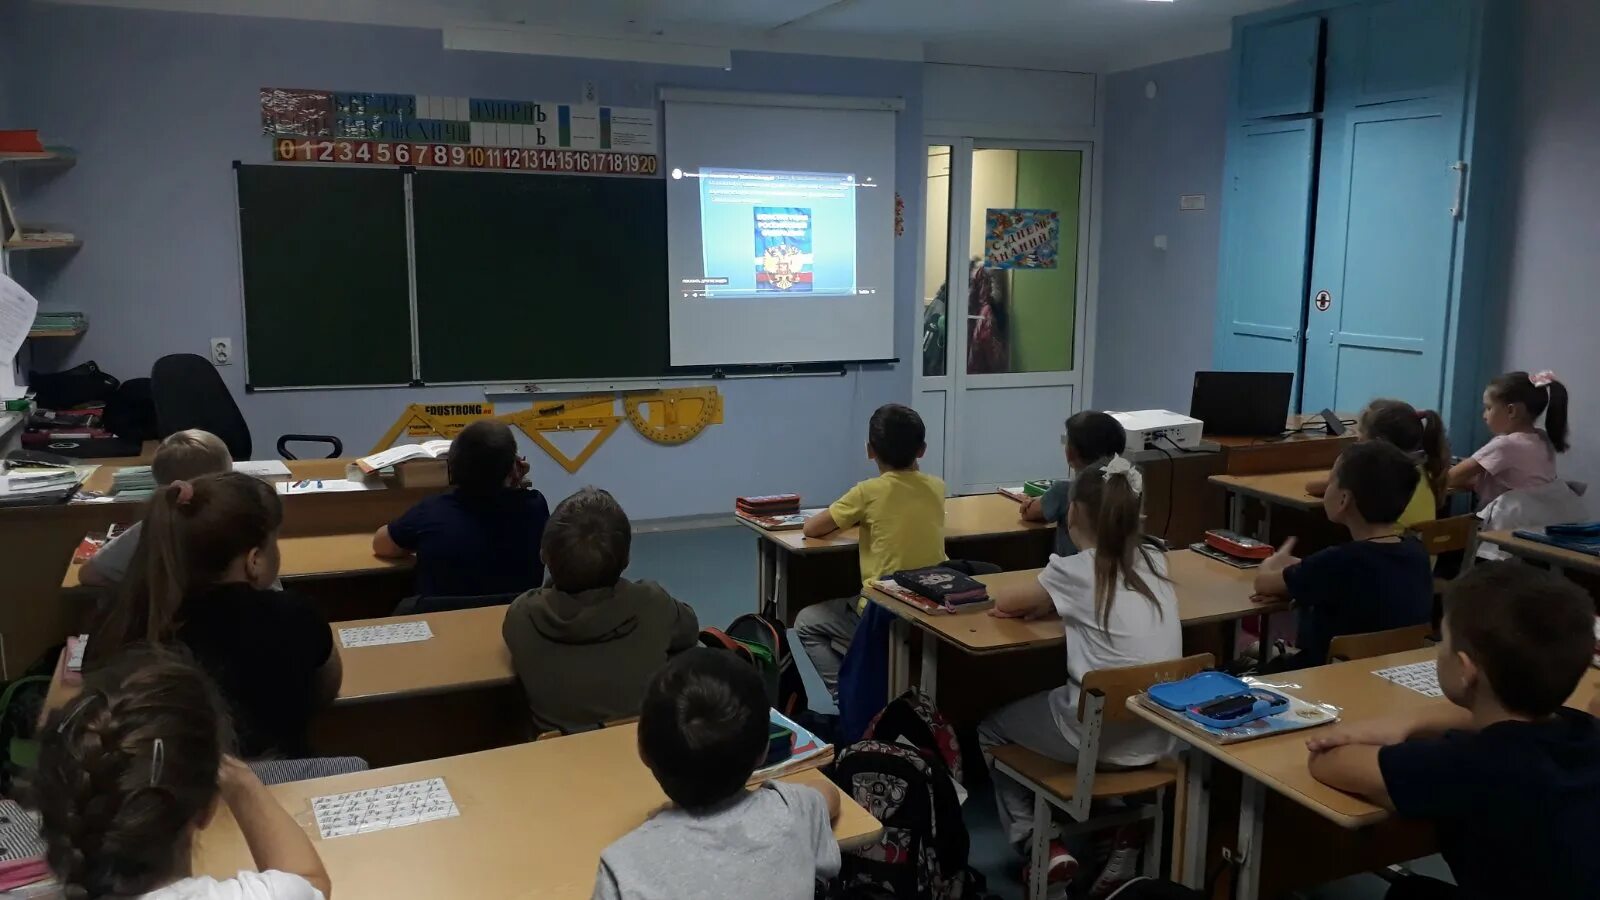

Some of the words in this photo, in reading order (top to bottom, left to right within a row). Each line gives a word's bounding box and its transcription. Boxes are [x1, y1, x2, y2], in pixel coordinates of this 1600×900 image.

[535, 104, 547, 122] Ъ
[536, 127, 546, 145] Ь
[280, 139, 295, 159] 0
[303, 140, 312, 160] 1
[319, 141, 334, 160] 2
[340, 141, 353, 160] 3
[356, 142, 370, 161] 4
[377, 143, 391, 162] 5
[395, 144, 409, 163] 6
[415, 145, 428, 164] 7
[434, 145, 448, 164] 8
[452, 146, 465, 165] 9
[467, 147, 484, 166] 10
[487, 148, 500, 167] 11
[504, 149, 520, 168] 12
[522, 149, 538, 168] 13
[540, 150, 557, 169] 14
[556, 151, 573, 170] 15
[574, 152, 590, 171] 16
[590, 153, 605, 171] 17
[607, 153, 623, 172] 18
[623, 154, 639, 173] 19
[640, 155, 656, 173] 20
